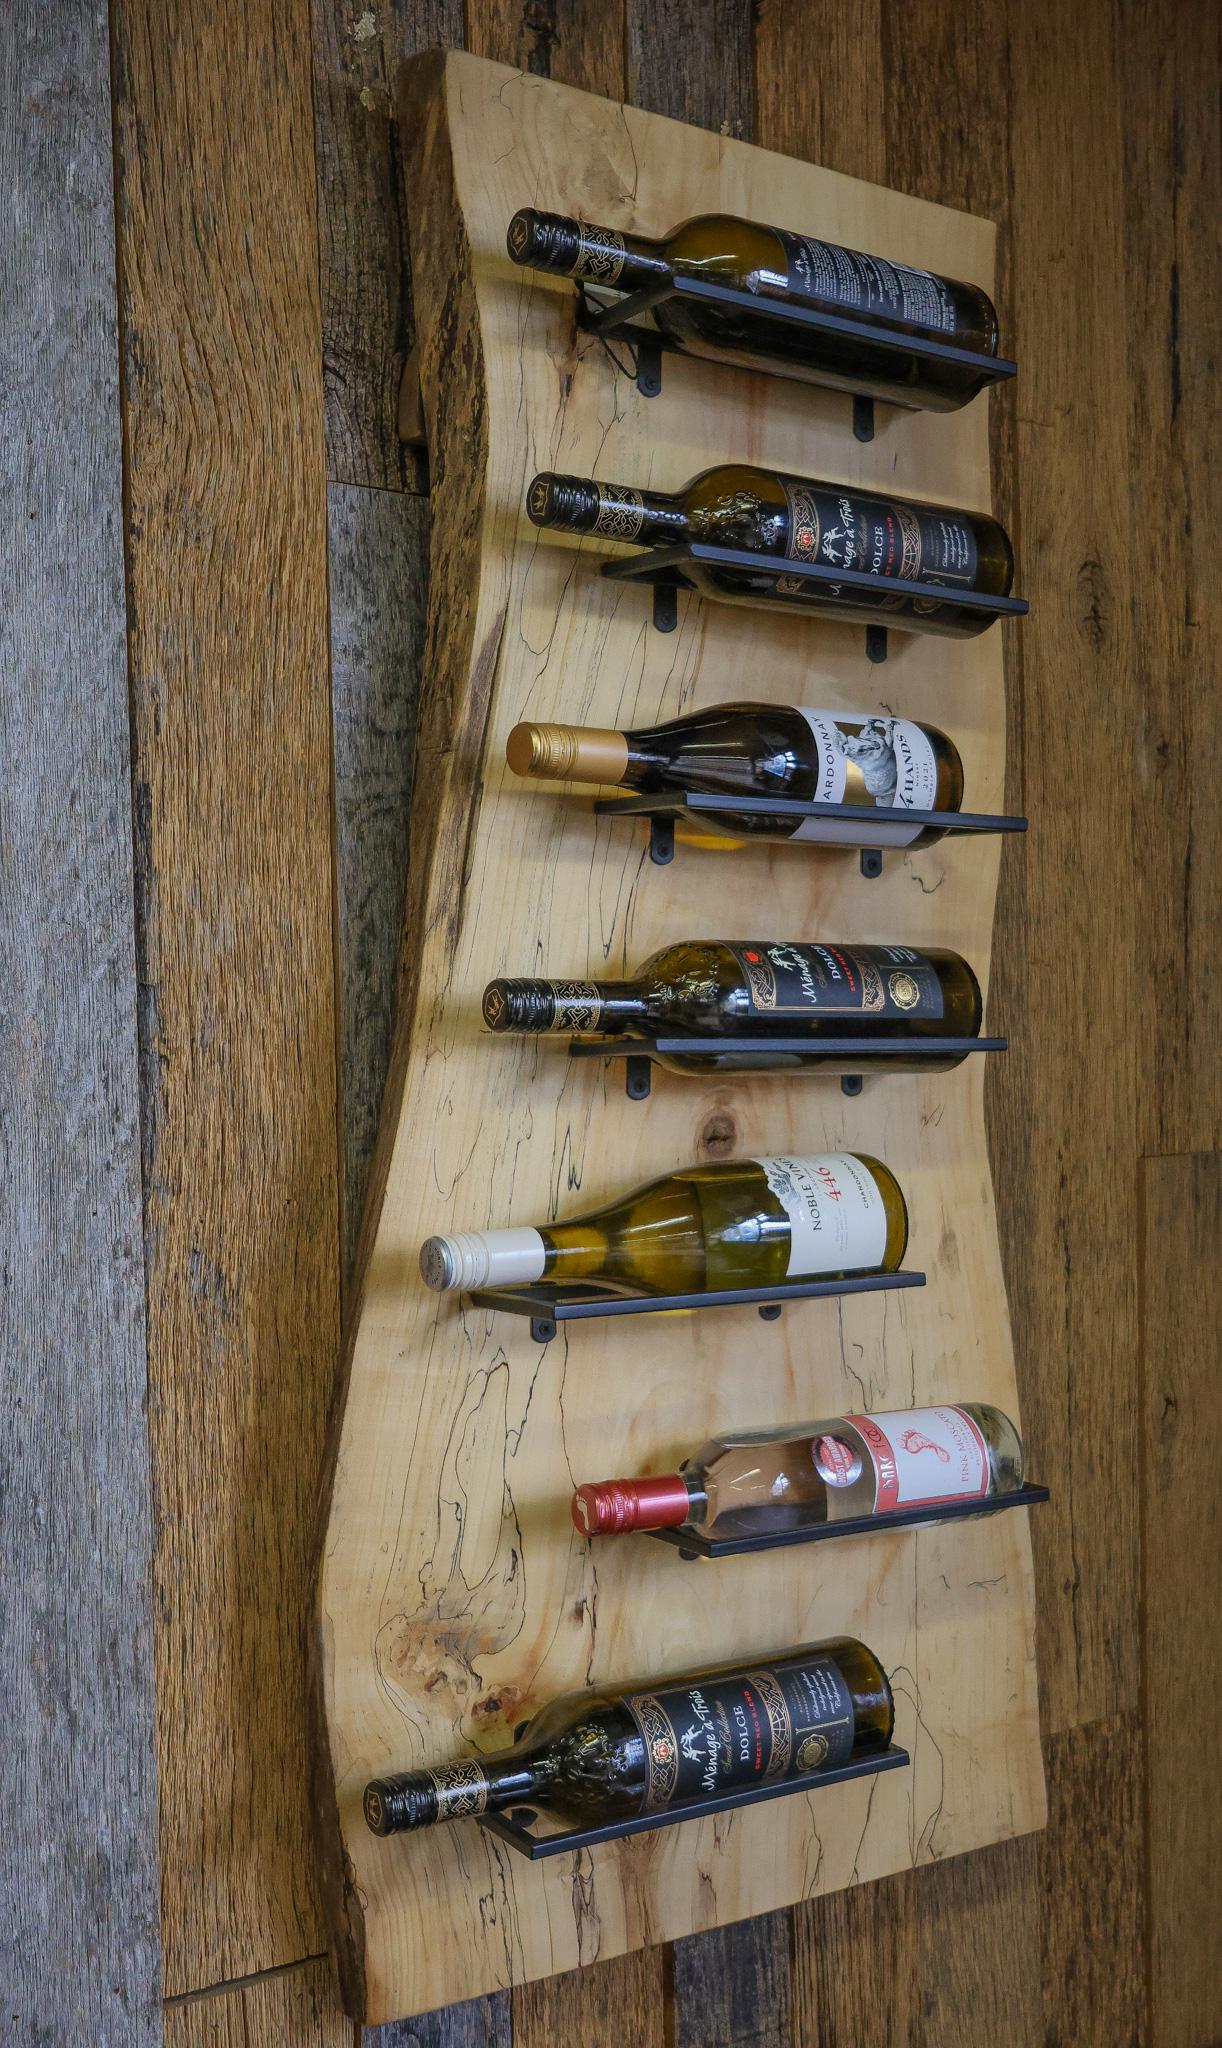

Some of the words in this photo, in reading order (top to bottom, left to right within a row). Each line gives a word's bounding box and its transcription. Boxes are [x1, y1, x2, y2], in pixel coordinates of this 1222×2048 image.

[838, 499, 854, 527] Trois
[896, 735, 914, 791] HANDS
[792, 954, 816, 1002] Ménage
[844, 967, 855, 992] SWEET
[778, 1158, 805, 1180] VINES
[810, 1167, 842, 1201] 446
[841, 1160, 868, 1208] CHARDONNAY
[801, 1184, 822, 1230] NOBLE
[934, 1412, 965, 1451] MOSCATO
[822, 1436, 842, 1462] AWARDED
[836, 1464, 846, 1483] MOST
[960, 1456, 968, 1481] PINK
[689, 1690, 710, 1720] Trois
[744, 1691, 758, 1718] BLEND
[702, 1720, 714, 1730] à
[715, 1700, 732, 1744] Collection
[733, 1706, 749, 1760] DOLCE
[753, 1722, 761, 1738] RED
[702, 1734, 720, 1790] Ménage
[754, 1742, 762, 1770] SWEET
